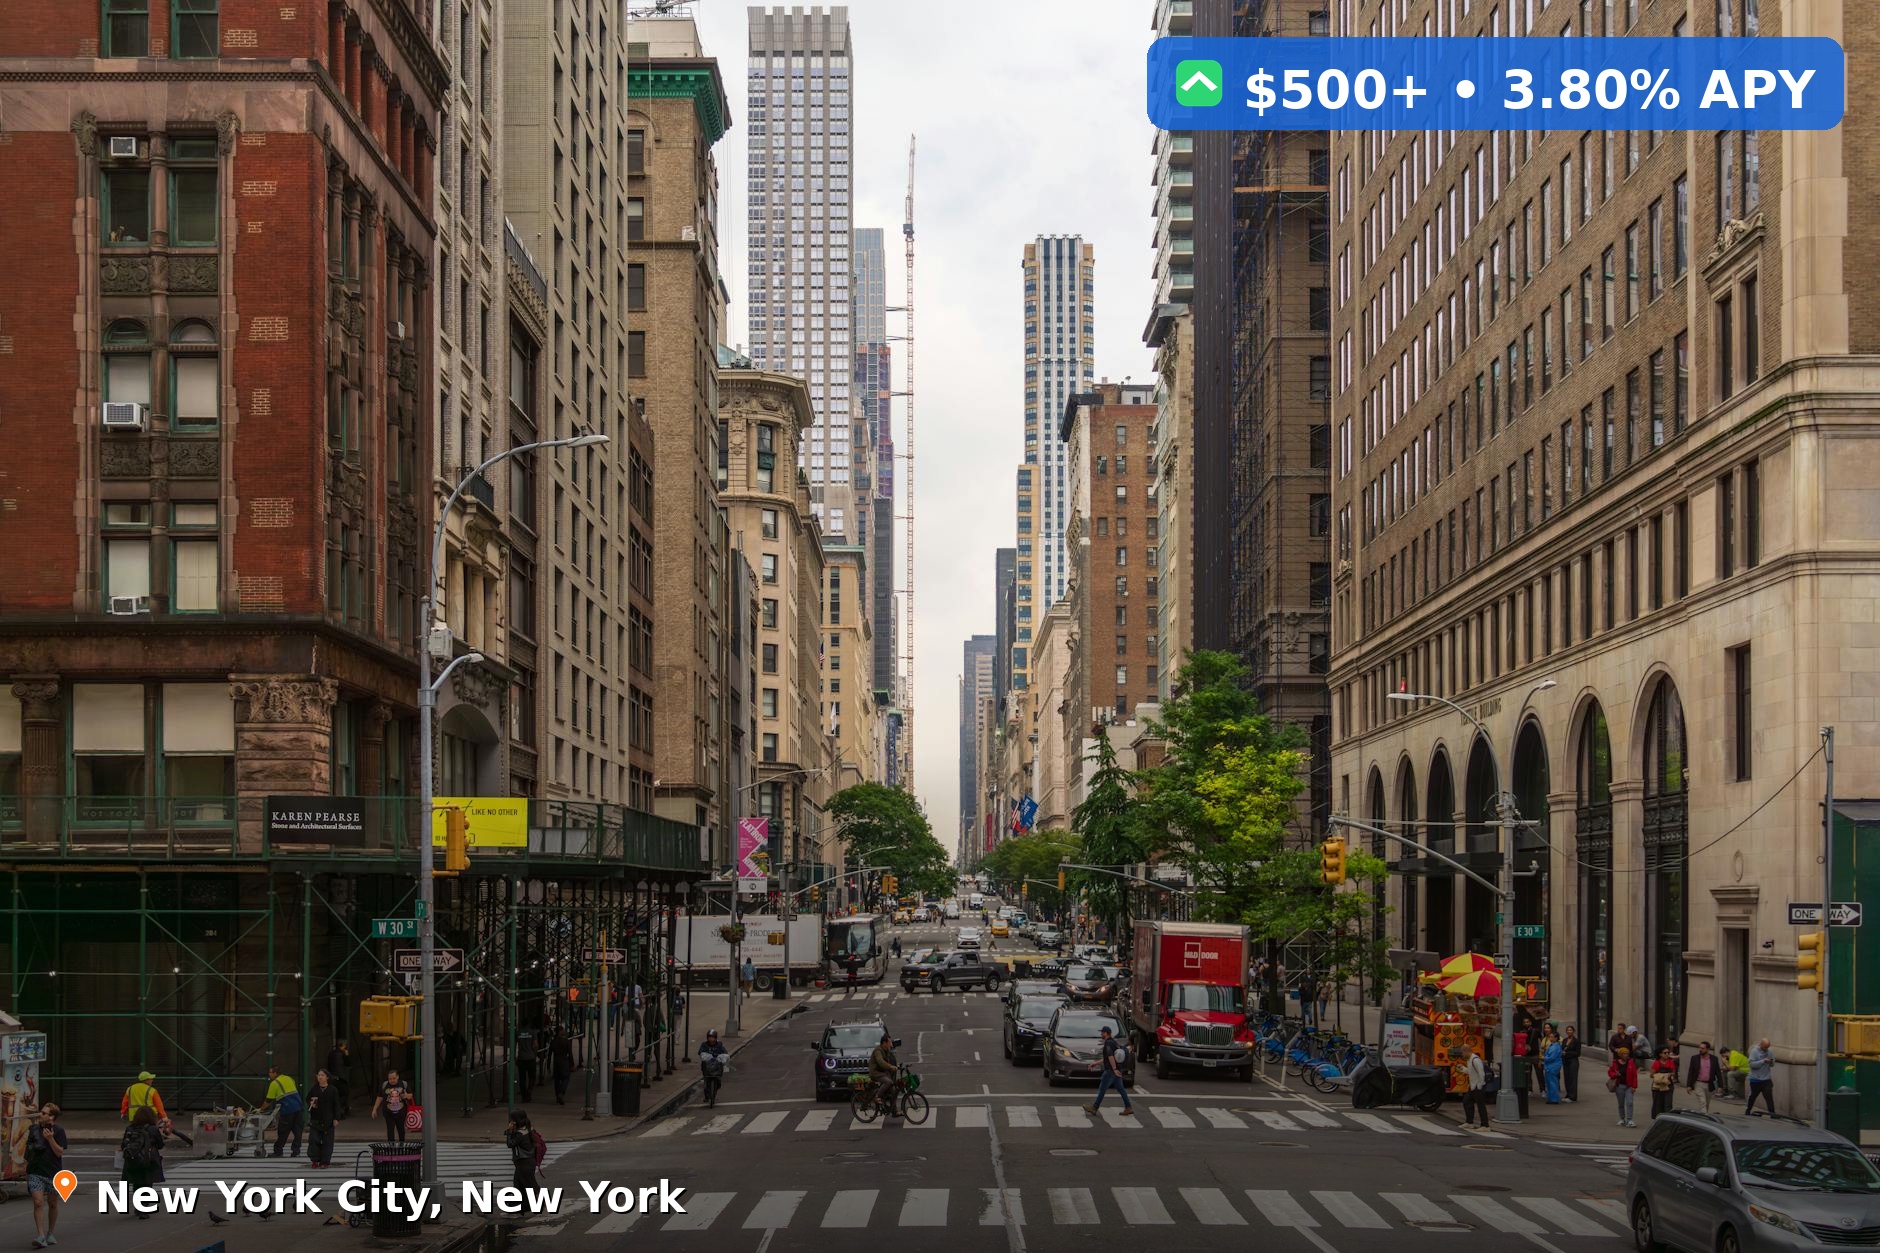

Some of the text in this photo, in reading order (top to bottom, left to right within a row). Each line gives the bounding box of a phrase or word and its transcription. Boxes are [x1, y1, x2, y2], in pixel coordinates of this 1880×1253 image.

[272, 812, 360, 822] KAREN PEARSE
[1794, 909, 1851, 919] ONE WAY
[378, 921, 387, 935] W
[389, 921, 404, 935] 30
[1517, 927, 1522, 936] E
[1524, 927, 1533, 936] 30
[402, 956, 452, 966] ONE WAY
[1200, 952, 1219, 960] DOOR
